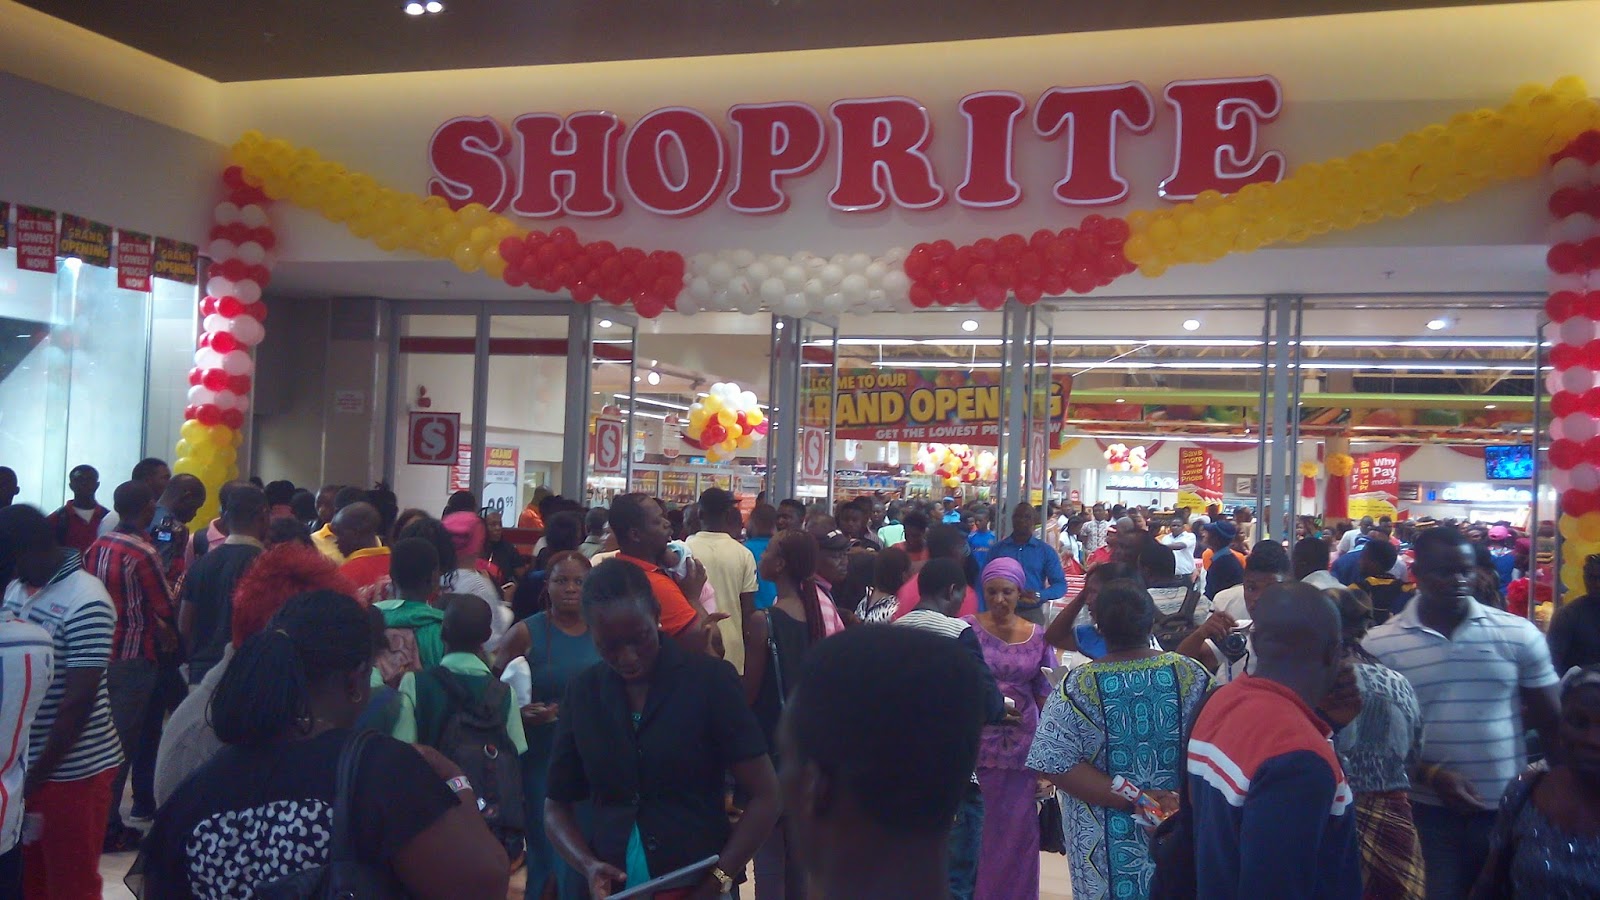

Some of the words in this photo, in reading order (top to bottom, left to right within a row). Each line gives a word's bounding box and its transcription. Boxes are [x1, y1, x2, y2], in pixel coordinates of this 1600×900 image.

[427, 75, 1286, 218] SHOPRITE
[68, 228, 104, 243] GRAND
[61, 240, 109, 257] OPENING
[156, 261, 195, 275] OPENING
[857, 374, 876, 389] TO
[877, 372, 908, 388] OUR
[875, 428, 898, 440] GET
[903, 427, 925, 438] THE
[929, 425, 978, 438] LOWEST
[1182, 450, 1203, 458] Save
[1182, 456, 1204, 464] more
[1373, 457, 1397, 467] Why
[1181, 468, 1204, 476] Lower
[1372, 467, 1397, 478] Pay
[1181, 474, 1204, 483] Prices
[1371, 476, 1397, 486] more?
